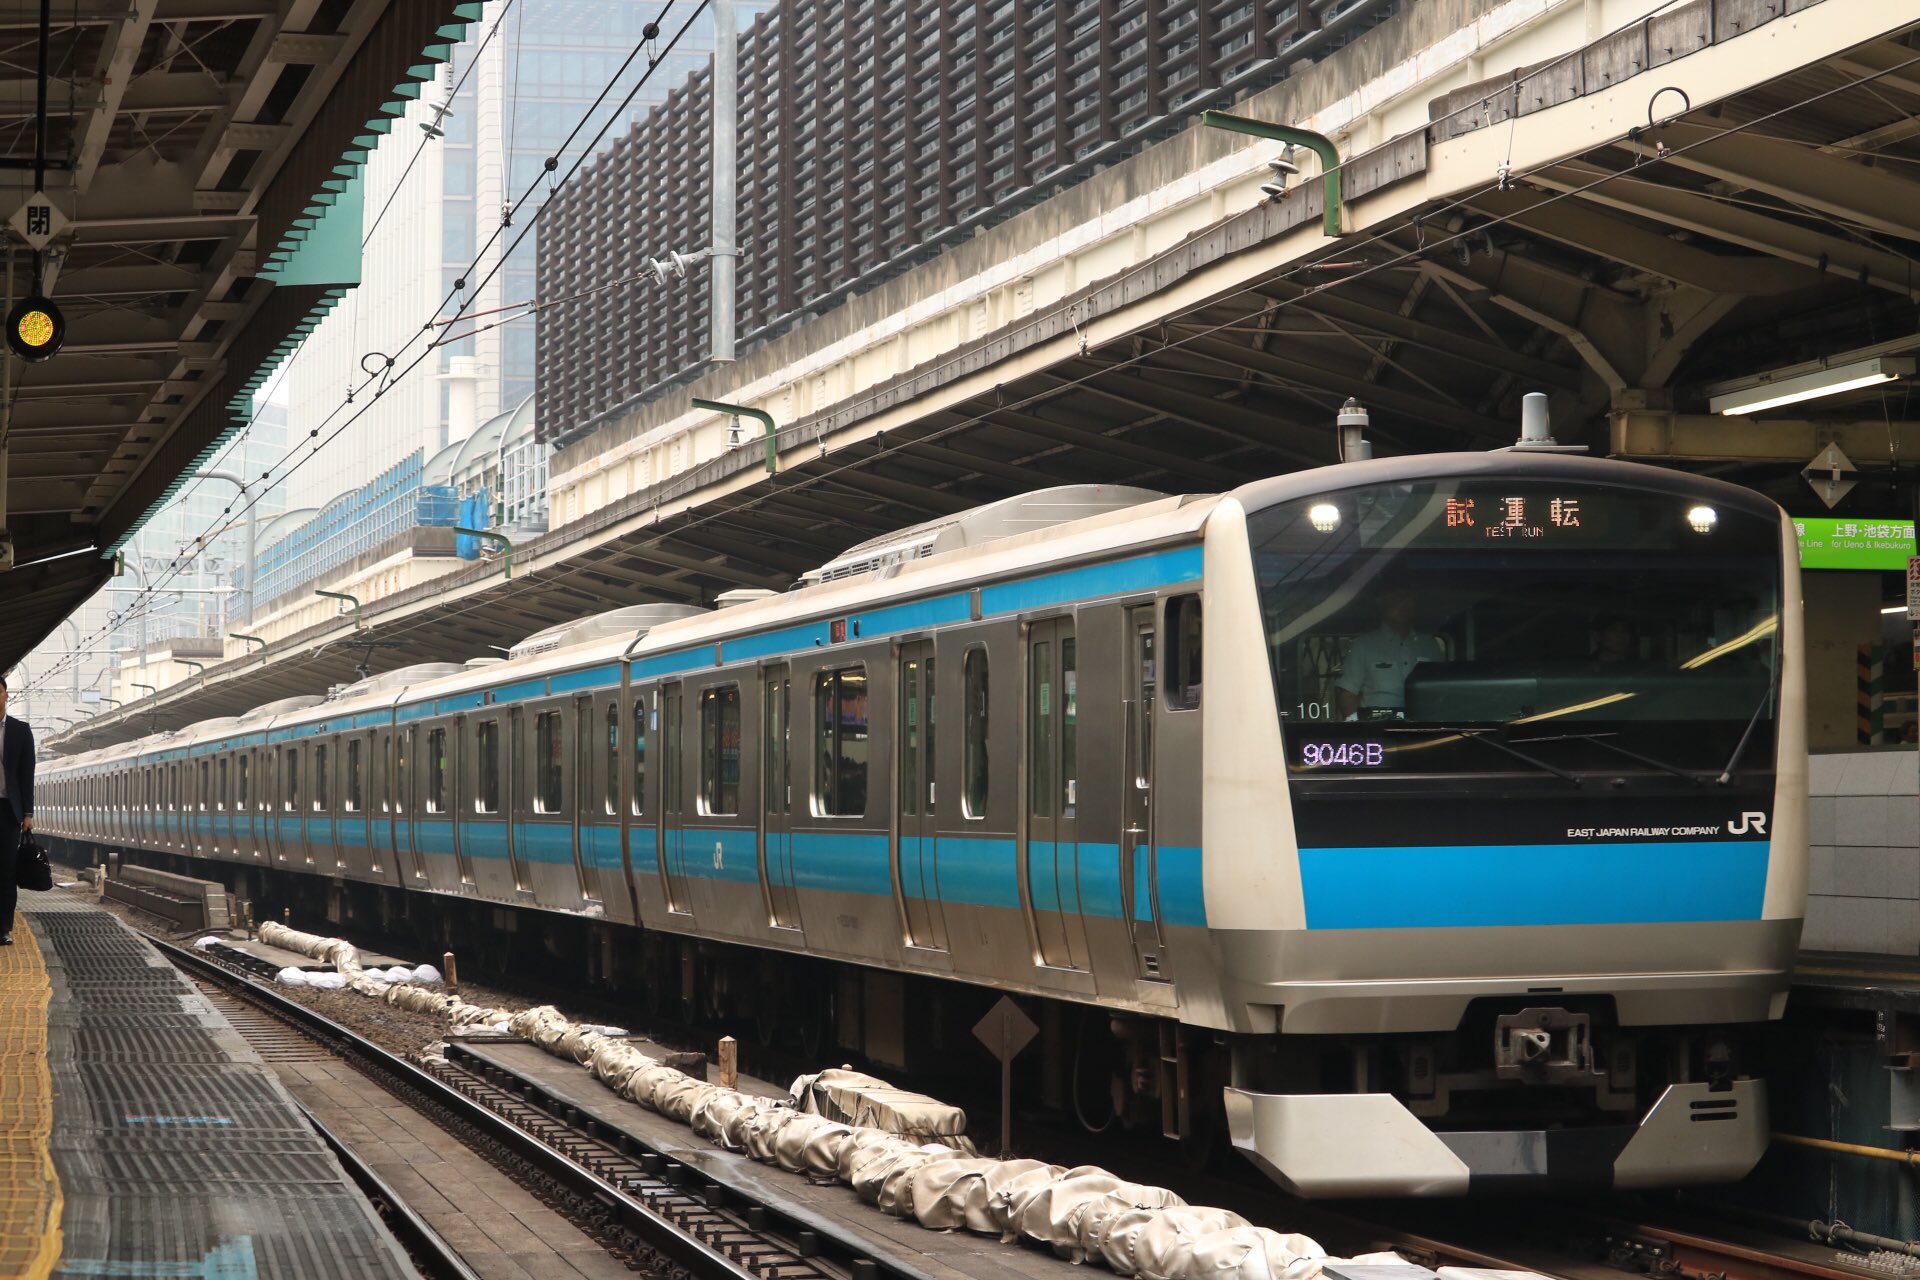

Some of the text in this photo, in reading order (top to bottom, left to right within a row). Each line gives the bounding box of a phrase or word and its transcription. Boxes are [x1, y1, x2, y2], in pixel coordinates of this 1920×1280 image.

[28, 207, 49, 235] 閉
[1485, 526, 1544, 537] TEST RUN
[1806, 540, 1823, 548] Line
[1831, 540, 1841, 548] for
[1843, 540, 1865, 549] Ueno
[1866, 541, 1872, 549] &
[1874, 540, 1911, 549] Ikebukuro
[1297, 702, 1331, 719] 101
[1303, 743, 1383, 766] 9046B
[1567, 826, 1720, 837] EAST JAPAN RAILWAY COMPANY
[1727, 811, 1767, 835] JR
